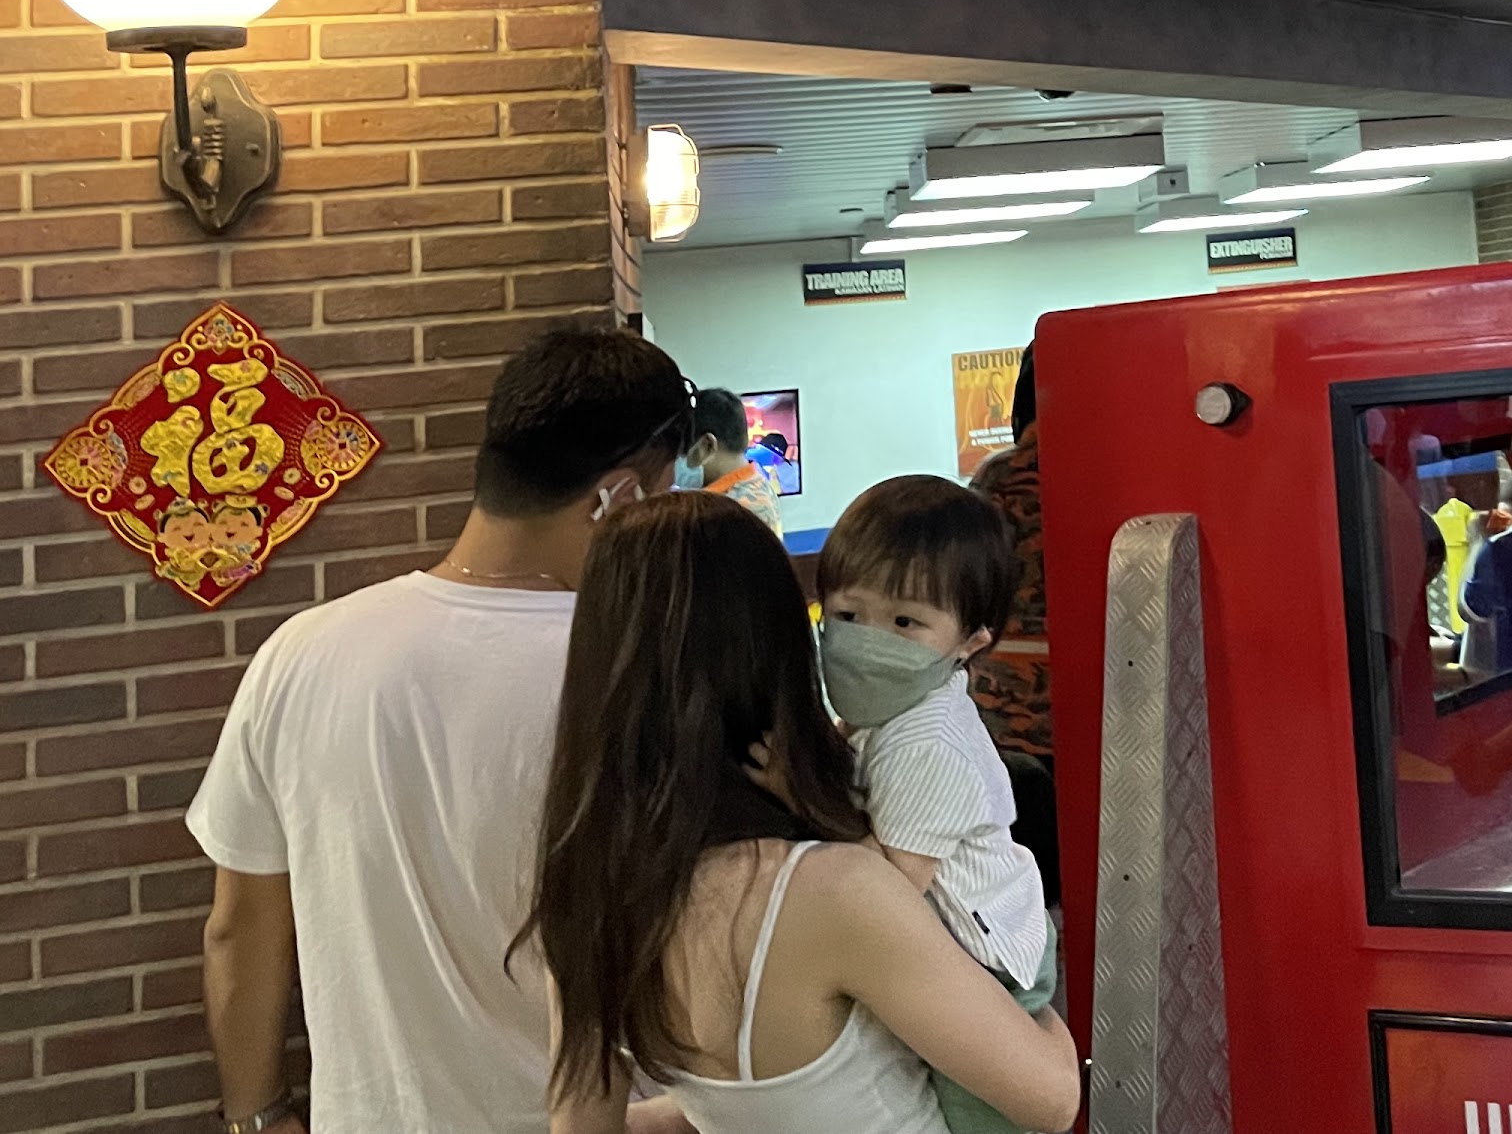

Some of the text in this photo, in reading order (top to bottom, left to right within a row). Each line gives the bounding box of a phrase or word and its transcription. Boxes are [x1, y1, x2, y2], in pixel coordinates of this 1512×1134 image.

[1209, 236, 1294, 259] EXTINGUISHER
[805, 269, 869, 291] TRAINING
[869, 268, 905, 287] AREA
[140, 358, 285, 498] 福
